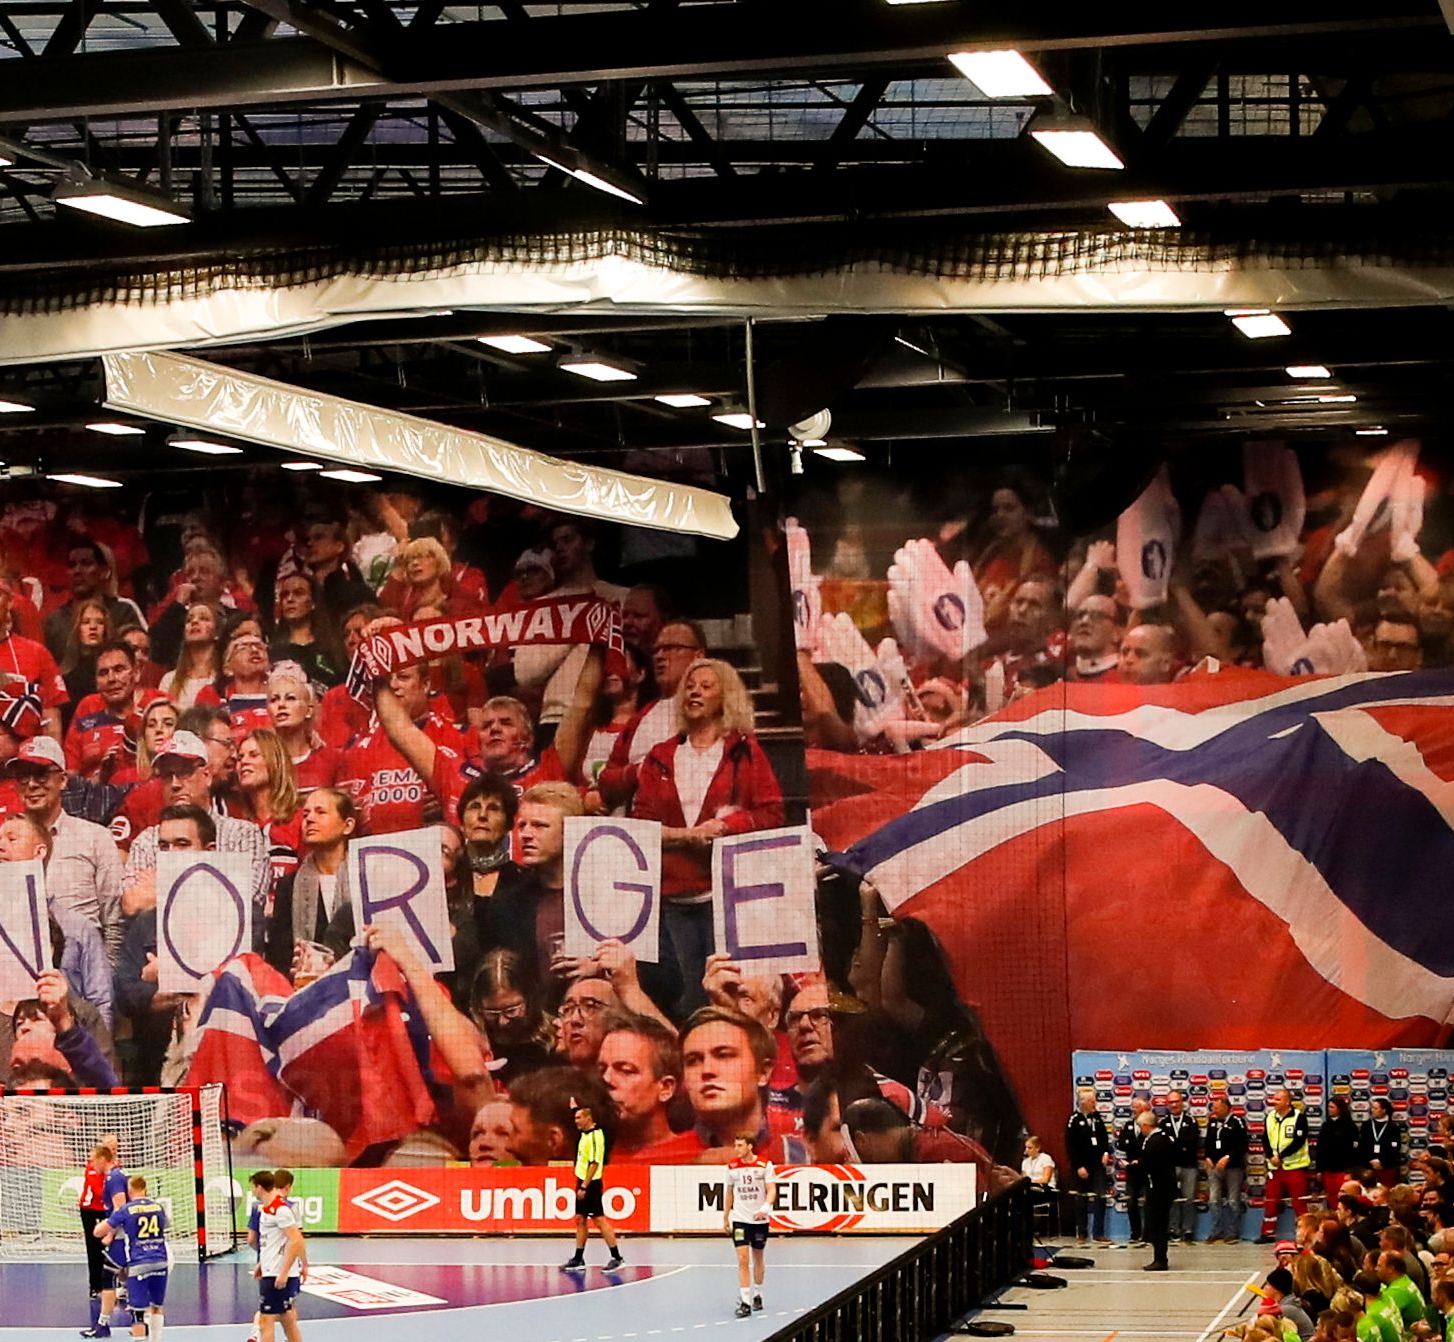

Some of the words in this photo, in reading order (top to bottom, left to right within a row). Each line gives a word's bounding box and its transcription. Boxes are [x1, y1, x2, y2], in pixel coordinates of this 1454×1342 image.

[391, 601, 590, 663] NORWAY
[742, 1175, 753, 1185] 19
[460, 1177, 636, 1220] umbo
[698, 1182, 936, 1212] MELRINGEN
[137, 1215, 160, 1239] 24
